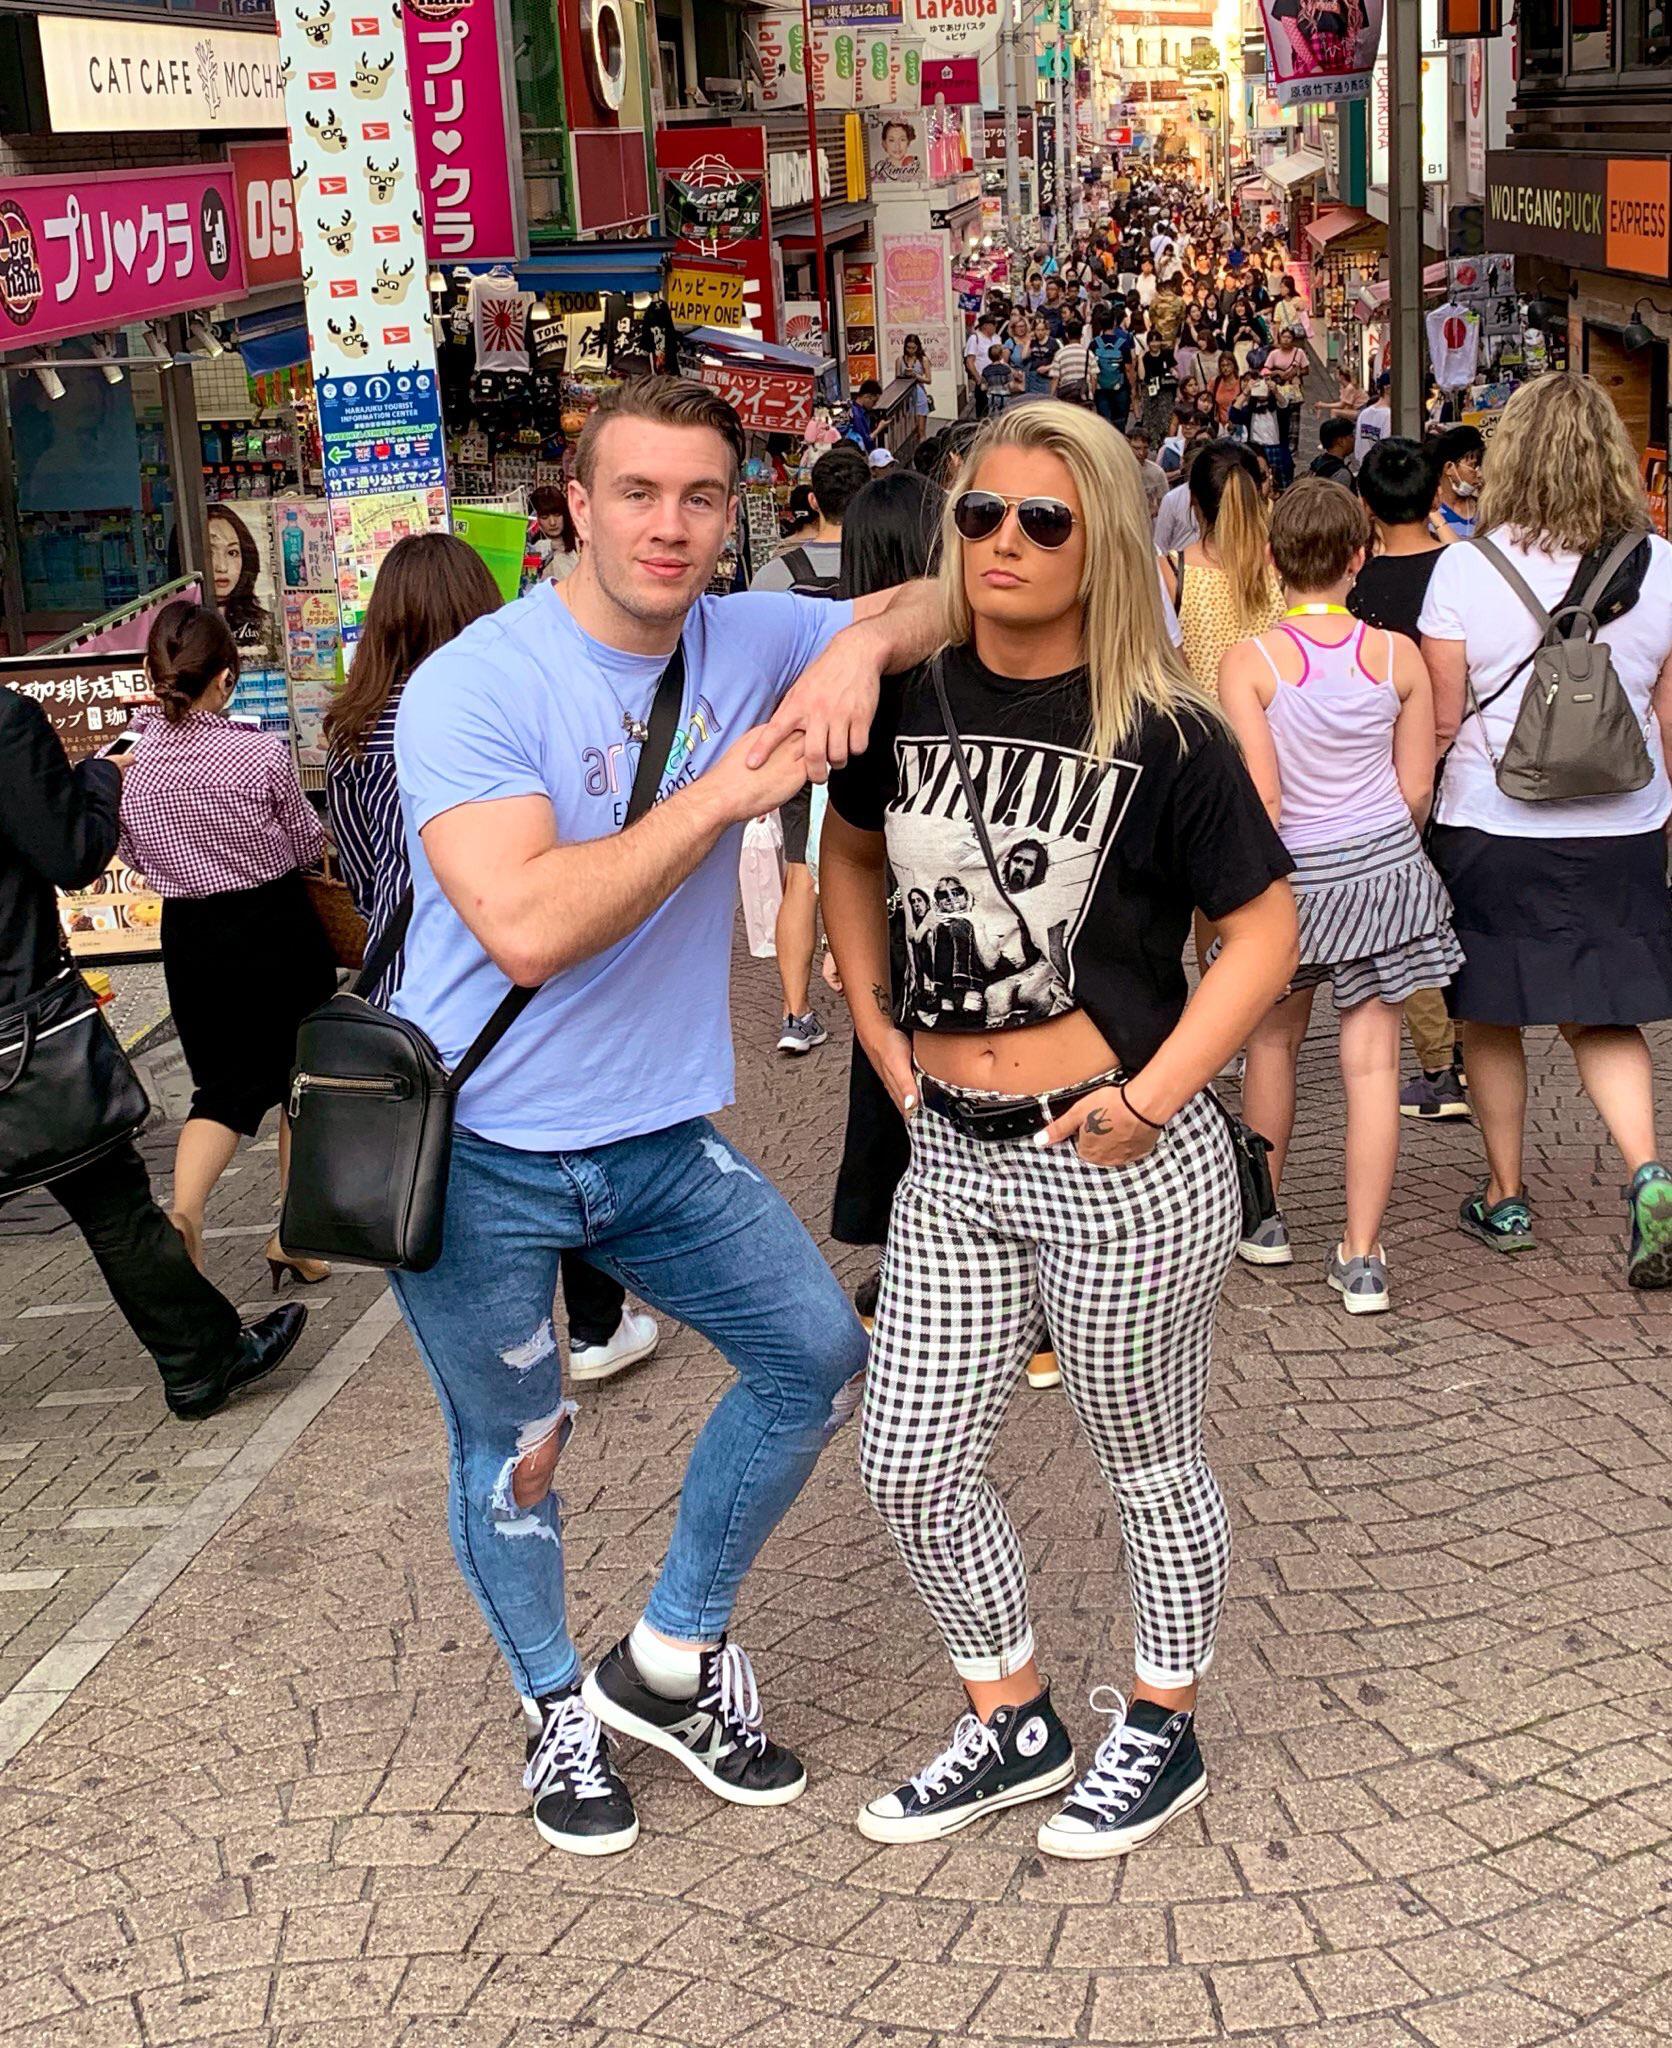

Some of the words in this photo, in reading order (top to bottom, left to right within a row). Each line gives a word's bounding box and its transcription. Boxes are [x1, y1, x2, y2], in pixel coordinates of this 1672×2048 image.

[90, 57, 132, 94] CAT
[140, 59, 192, 95] CAFE
[224, 61, 285, 98] MOCHA
[1377, 66, 1389, 150] PURIKURA
[1428, 164, 1443, 174] B1
[687, 189, 737, 204] LASER
[697, 207, 740, 222] TRAP
[743, 212, 760, 224] 3F
[1490, 184, 1562, 229] WOLFGANG
[1563, 191, 1602, 235] PUCK
[1610, 200, 1665, 238] EXPRESS
[671, 277, 742, 300] ハッピーワン
[670, 301, 711, 322] HAPPY
[714, 305, 740, 324] ONE
[702, 369, 812, 393] 原宿ハッピーワン
[341, 412, 391, 423] INFORMATION
[392, 409, 418, 418] CENTER
[384, 402, 413, 412] TOURIST
[329, 467, 442, 492] 竹下通り公式マップ
[888, 743, 1121, 849] NIRVANA
